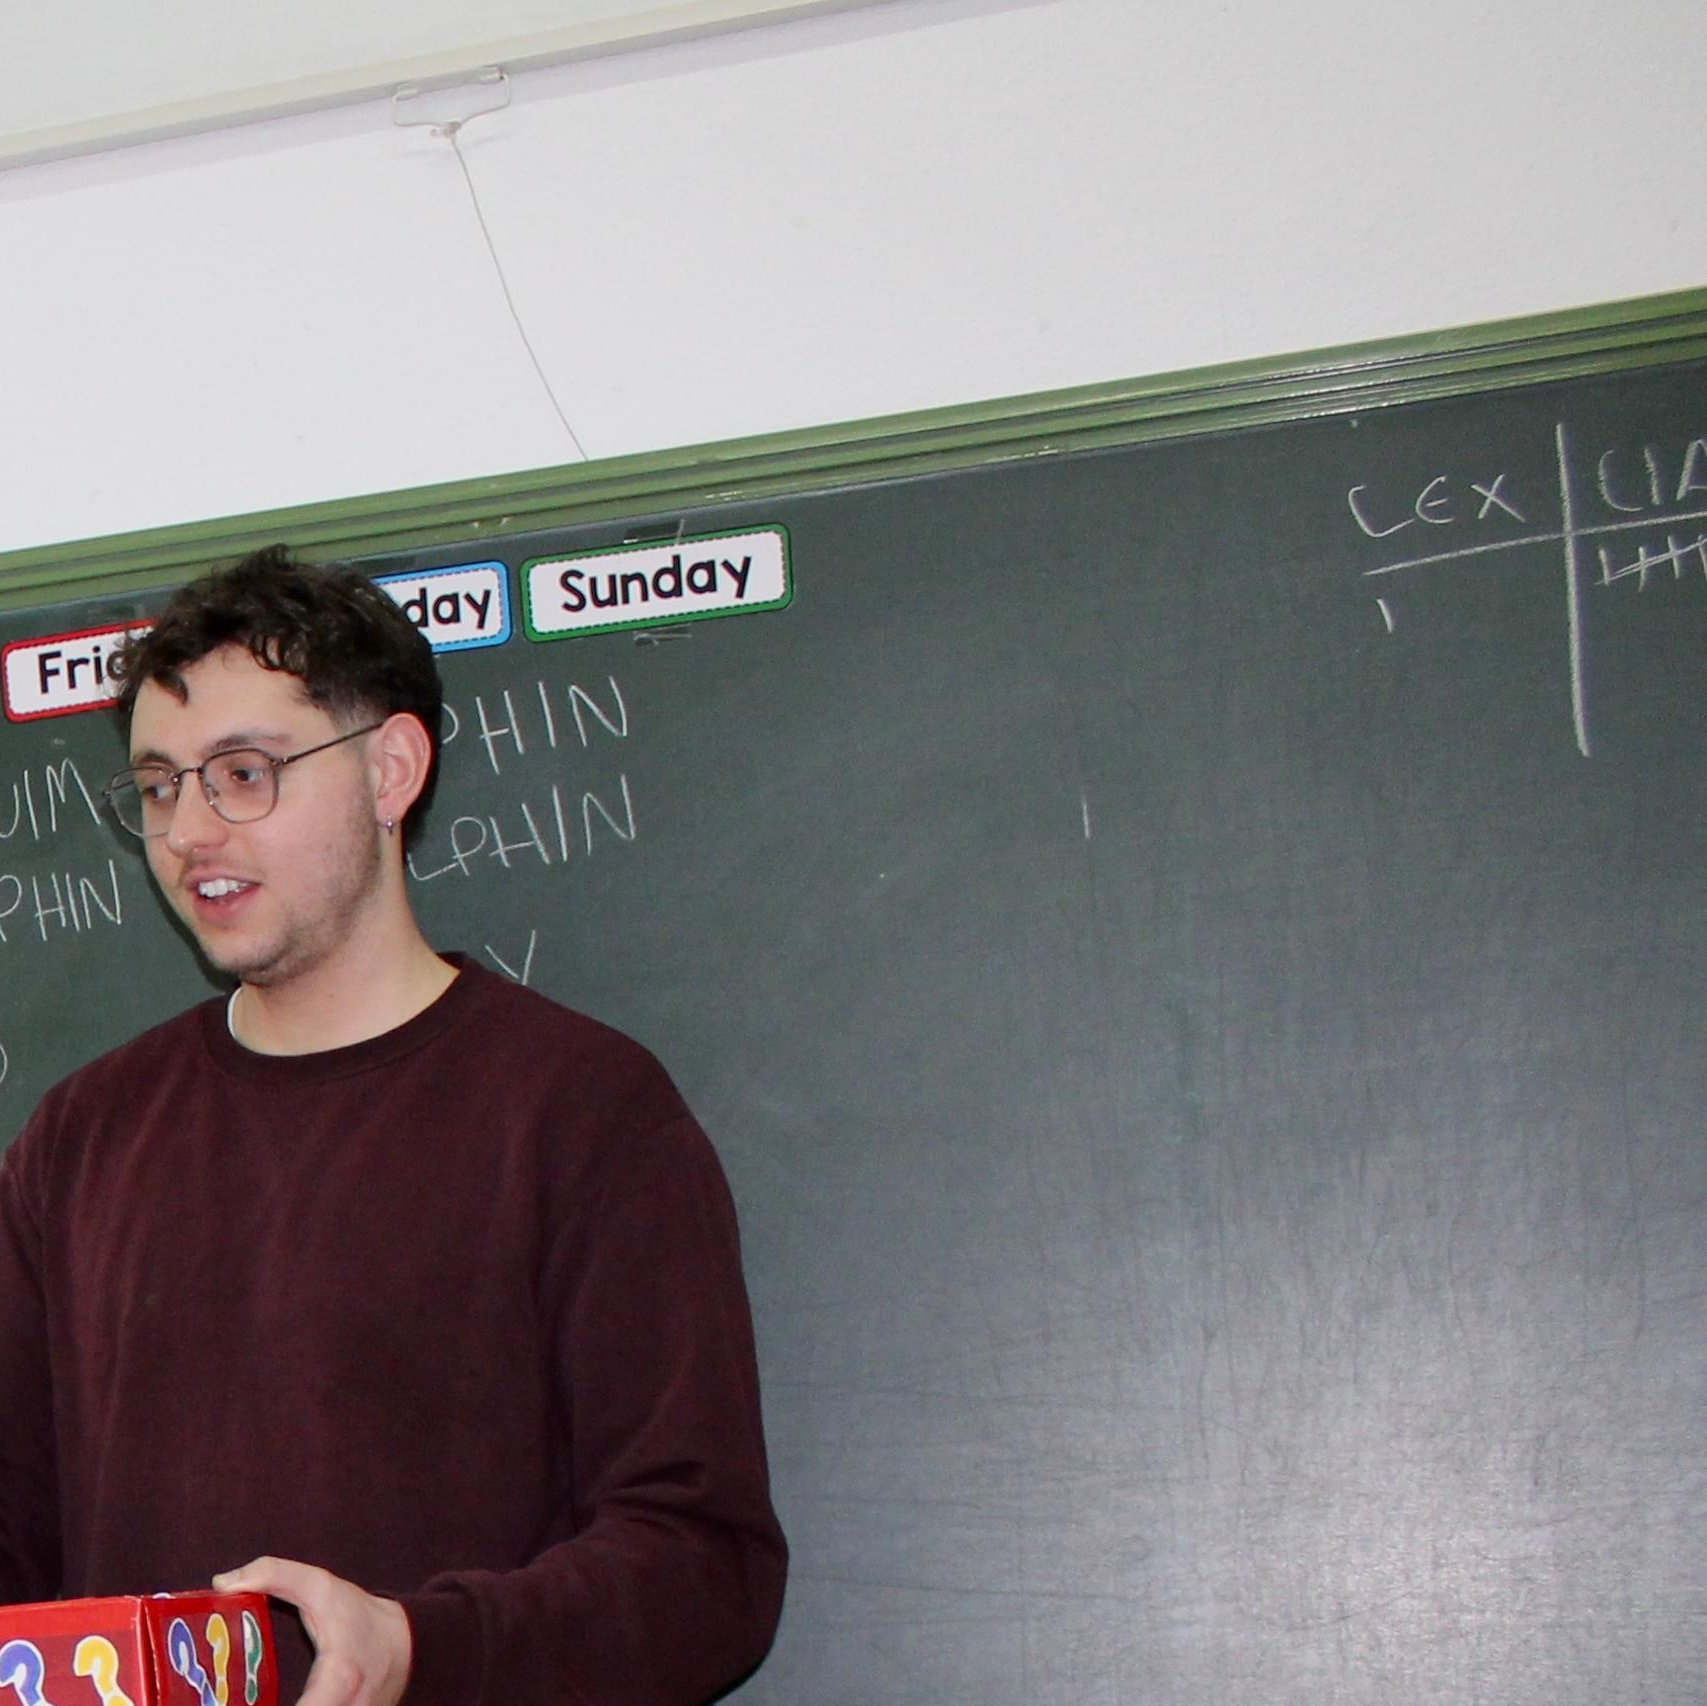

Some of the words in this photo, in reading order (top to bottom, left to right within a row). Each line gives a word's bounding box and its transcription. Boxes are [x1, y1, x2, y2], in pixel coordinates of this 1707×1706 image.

[402, 587, 491, 629] day
[559, 554, 751, 613] Sunday
[407, 774, 636, 881] LPHIN
